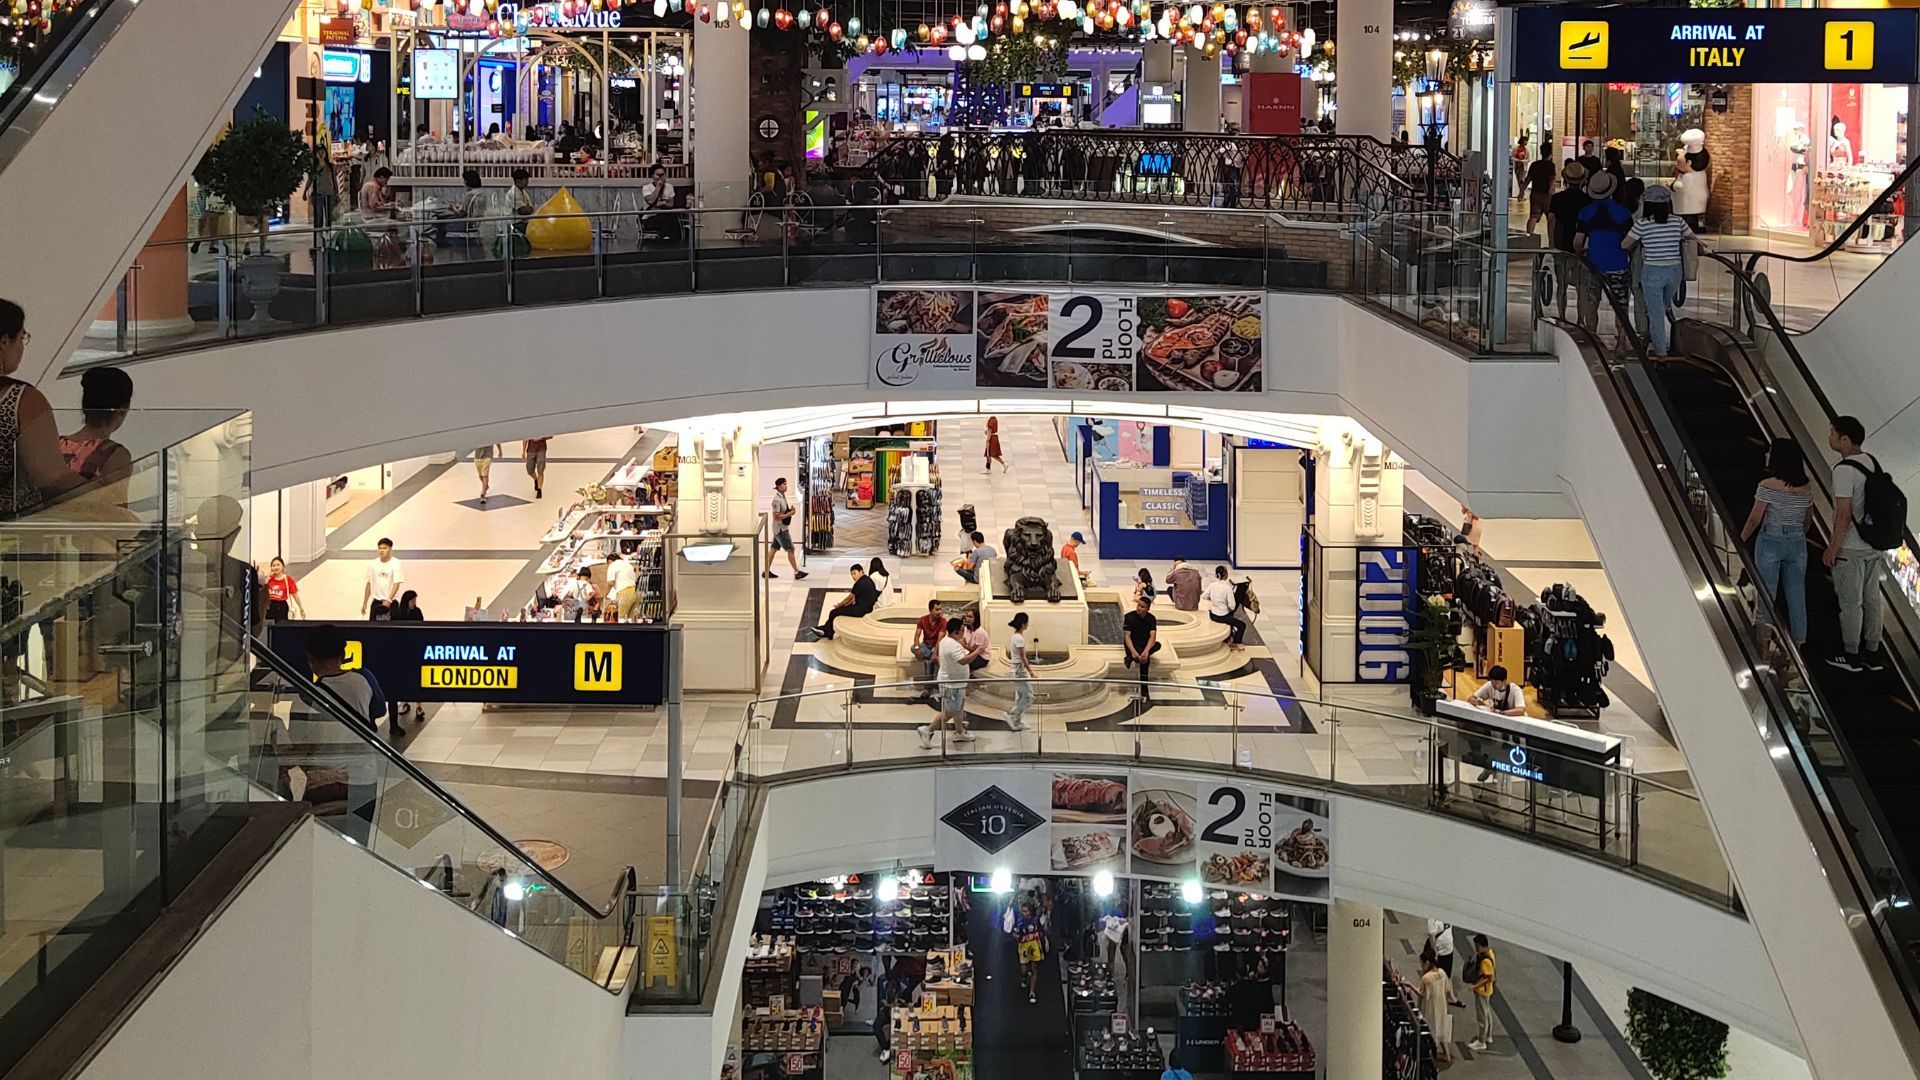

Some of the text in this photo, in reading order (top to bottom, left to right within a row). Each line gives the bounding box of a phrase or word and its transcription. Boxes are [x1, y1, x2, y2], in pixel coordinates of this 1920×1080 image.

[1363, 25, 1380, 34] 104
[1670, 25, 1765, 40] ARRIVAL AT
[1840, 30, 1854, 61] 1
[1689, 48, 1745, 67] ITALY
[1051, 296, 1116, 360] 2 nd
[1118, 297, 1133, 360] FLOOR
[678, 456, 697, 464] M03
[1384, 462, 1403, 470] M04
[1143, 488, 1186, 496] TIMELESS.
[1145, 502, 1183, 510] CLASSIC.
[1149, 516, 1178, 524] STYLE.
[423, 645, 516, 661] ARRIVAL AT
[584, 651, 612, 682] M
[430, 668, 509, 686] LONDON
[1491, 760, 1511, 772] FREE
[963, 804, 992, 817] ITALIAN
[1200, 786, 1257, 848] 2 nd
[1258, 792, 1272, 849] FLOOR
[1353, 918, 1371, 928] G04
